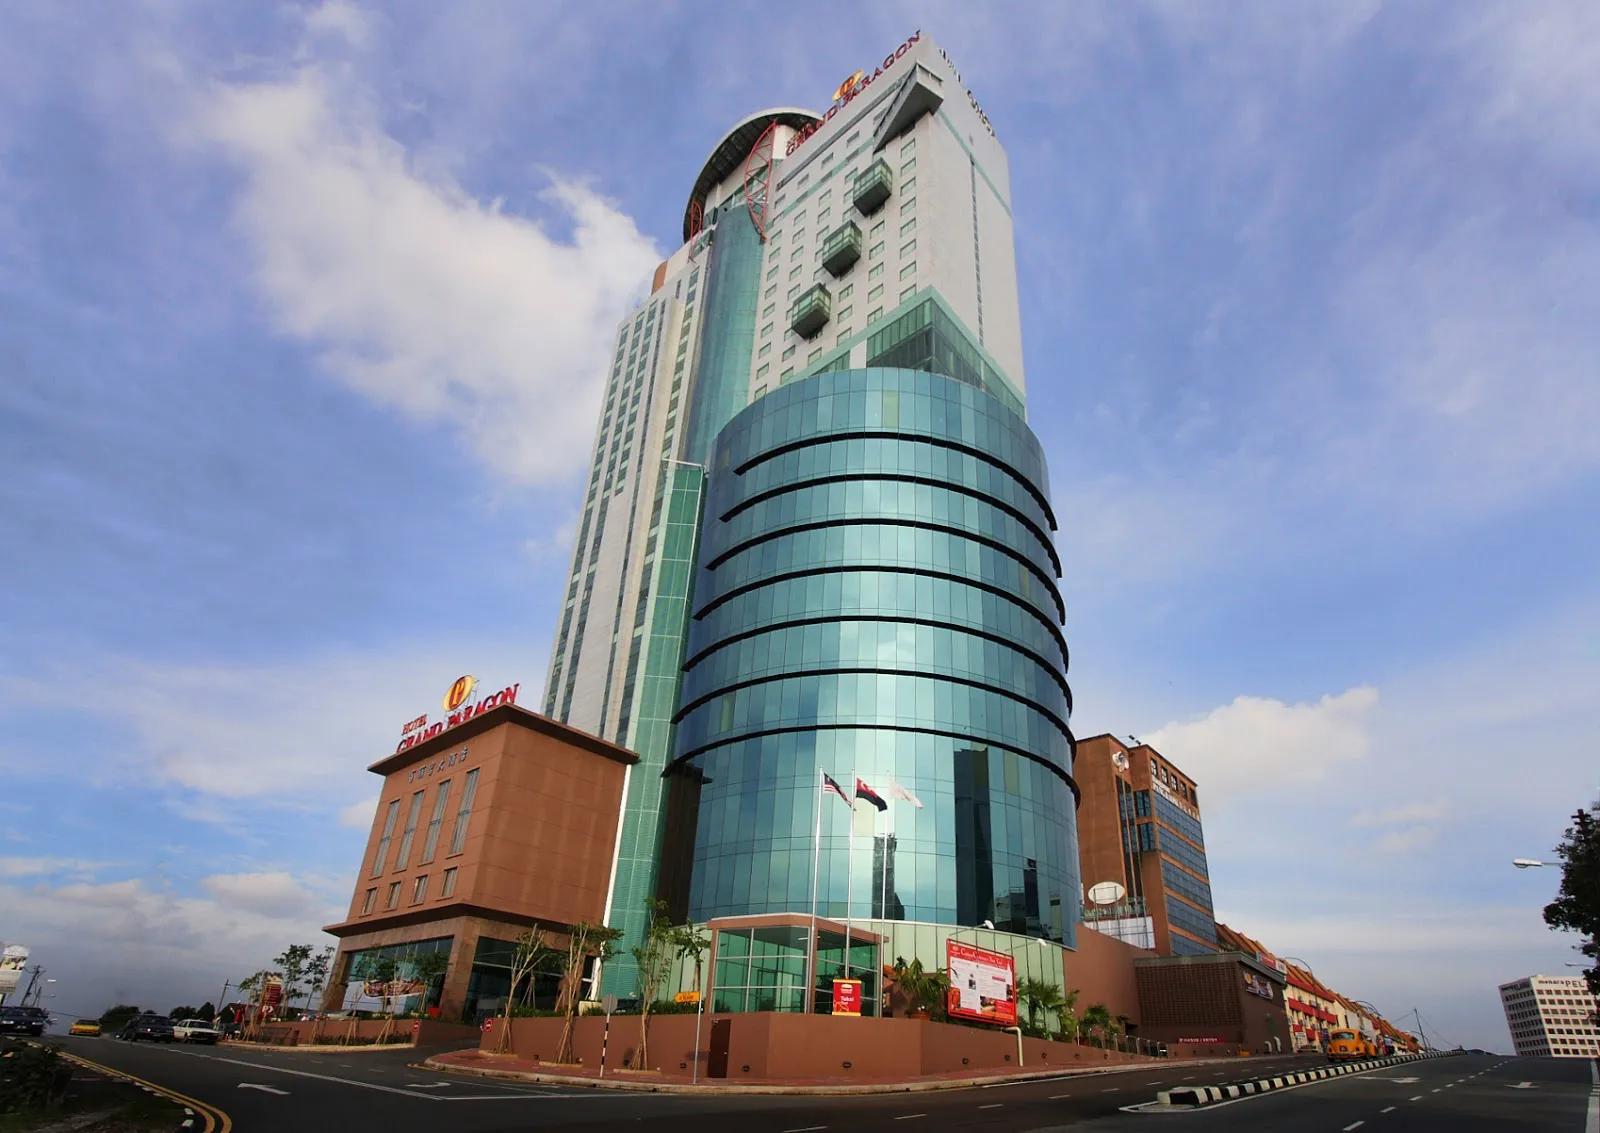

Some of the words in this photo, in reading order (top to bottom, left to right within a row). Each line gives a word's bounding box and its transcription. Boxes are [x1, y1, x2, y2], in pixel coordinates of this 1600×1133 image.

[786, 104, 839, 157] GRAND
[842, 29, 921, 108] PARAGON
[397, 722, 443, 753] GRAND
[447, 683, 519, 729] PARAGON
[402, 714, 427, 735] HOTEL
[1565, 980, 1586, 988] PEL
